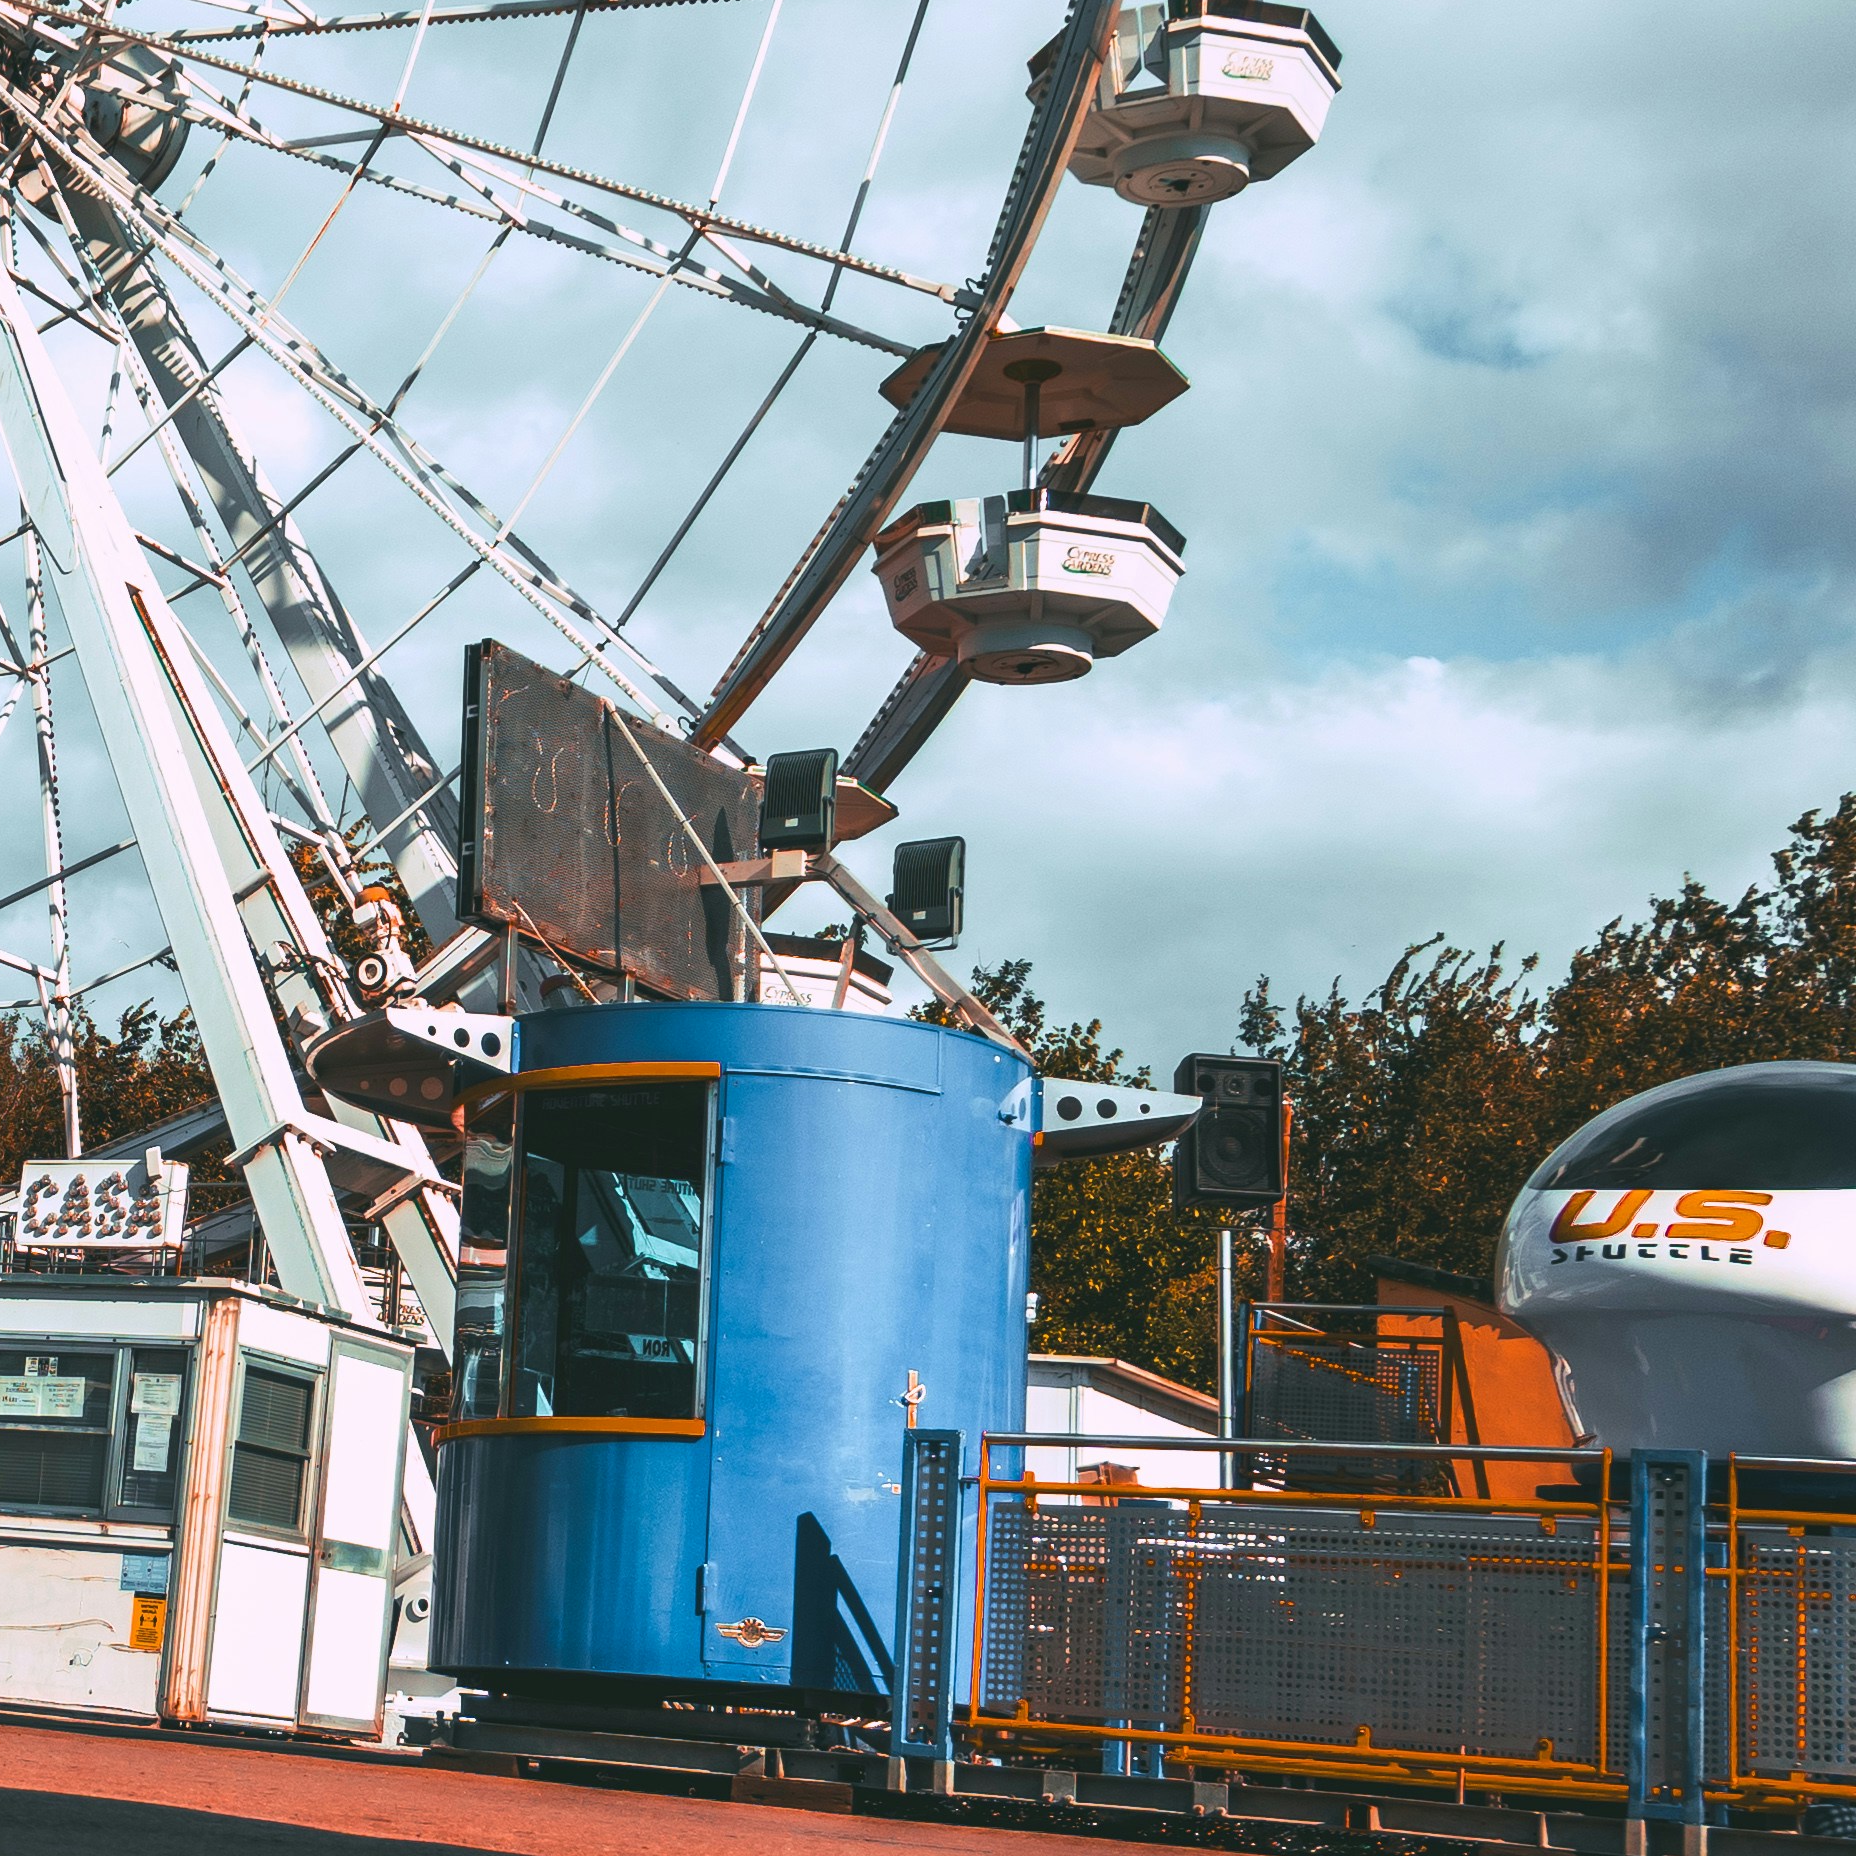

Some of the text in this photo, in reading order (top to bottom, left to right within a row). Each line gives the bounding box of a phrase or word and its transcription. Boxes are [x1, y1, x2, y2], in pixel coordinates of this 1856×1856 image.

[1062, 558, 1111, 575] GARDENS
[1067, 546, 1114, 564] CYPRESS
[24, 1170, 164, 1237] CASH
[1549, 1189, 1791, 1249] U.S.
